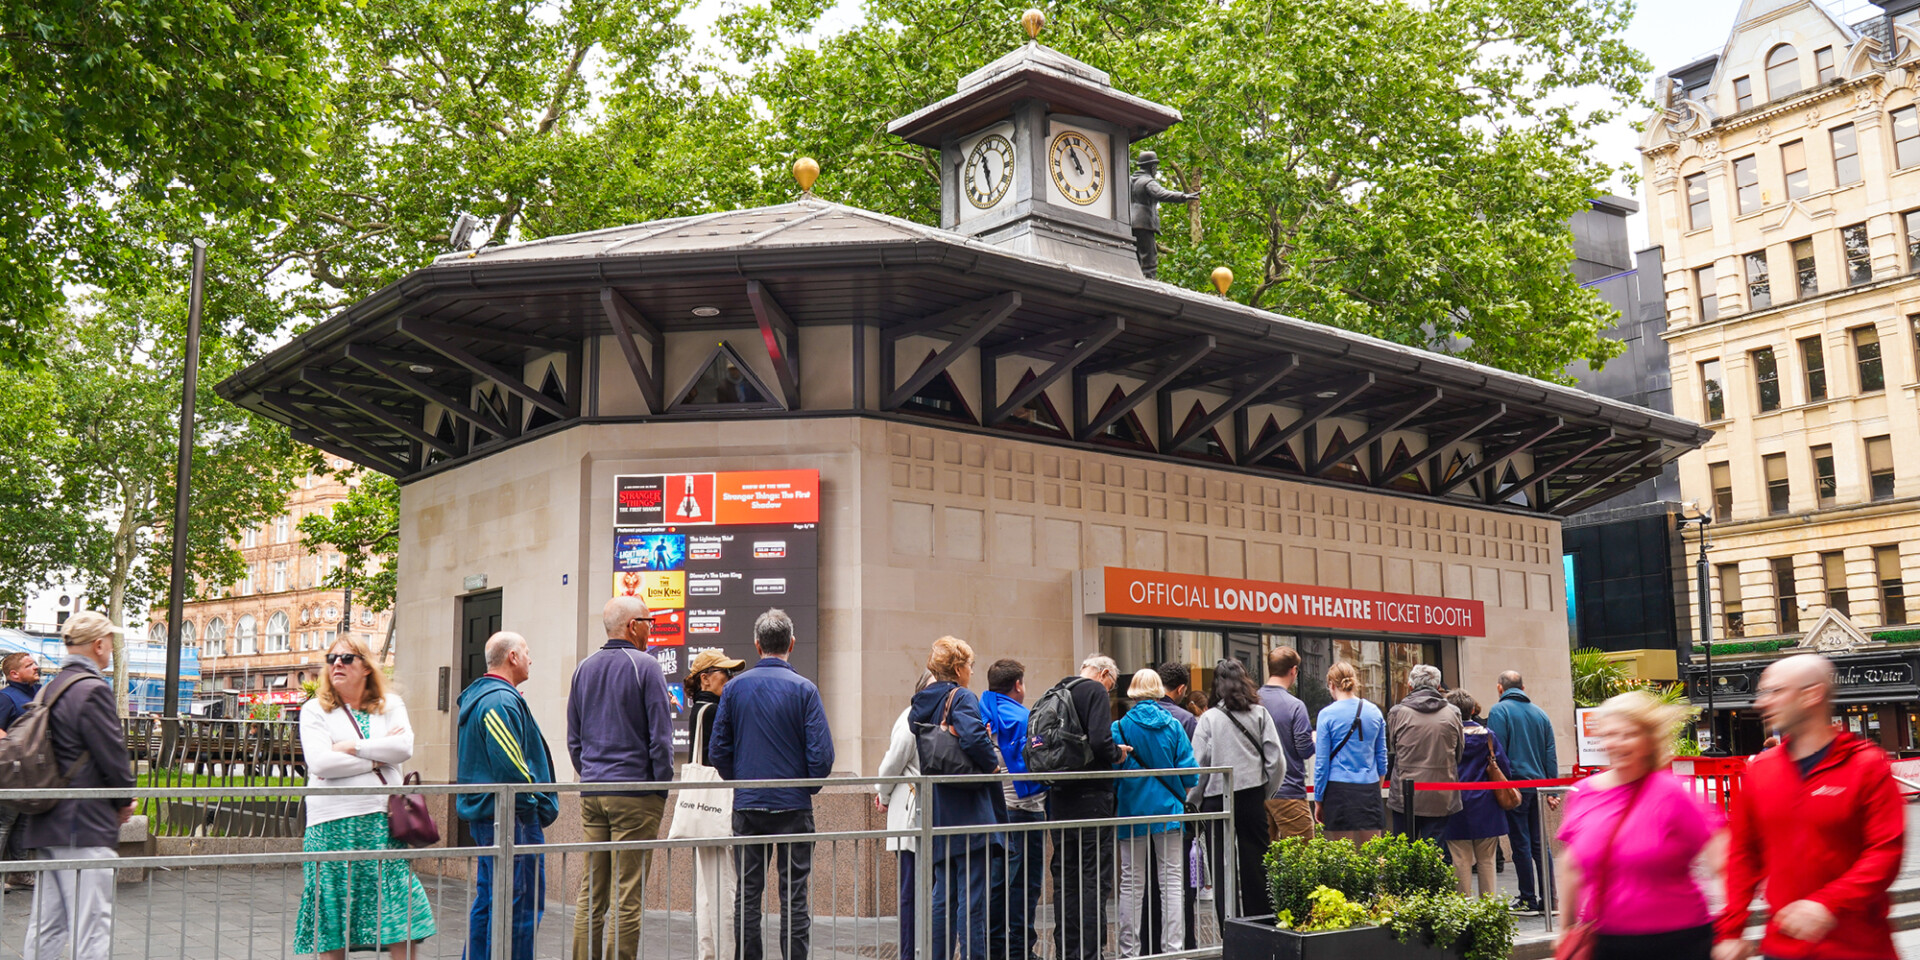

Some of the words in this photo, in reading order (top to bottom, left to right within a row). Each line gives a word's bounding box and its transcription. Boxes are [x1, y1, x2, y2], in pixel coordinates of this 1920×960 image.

[619, 490, 662, 503] STRANGER
[723, 492, 754, 502] Stranger
[755, 491, 780, 501] Things:
[781, 491, 794, 499] The
[627, 500, 655, 508] THINGS
[751, 501, 782, 509] Shadow
[1130, 581, 1210, 608] OFFICIAL
[1215, 588, 1298, 614] LONDON
[1302, 595, 1371, 620] THEATRE
[1375, 601, 1420, 623] TICKET
[1425, 606, 1472, 627] BOOTH
[658, 650, 676, 662] MAD
[1864, 669, 1903, 683] Water
[680, 801, 695, 809] Kave
[697, 802, 722, 813] Home
